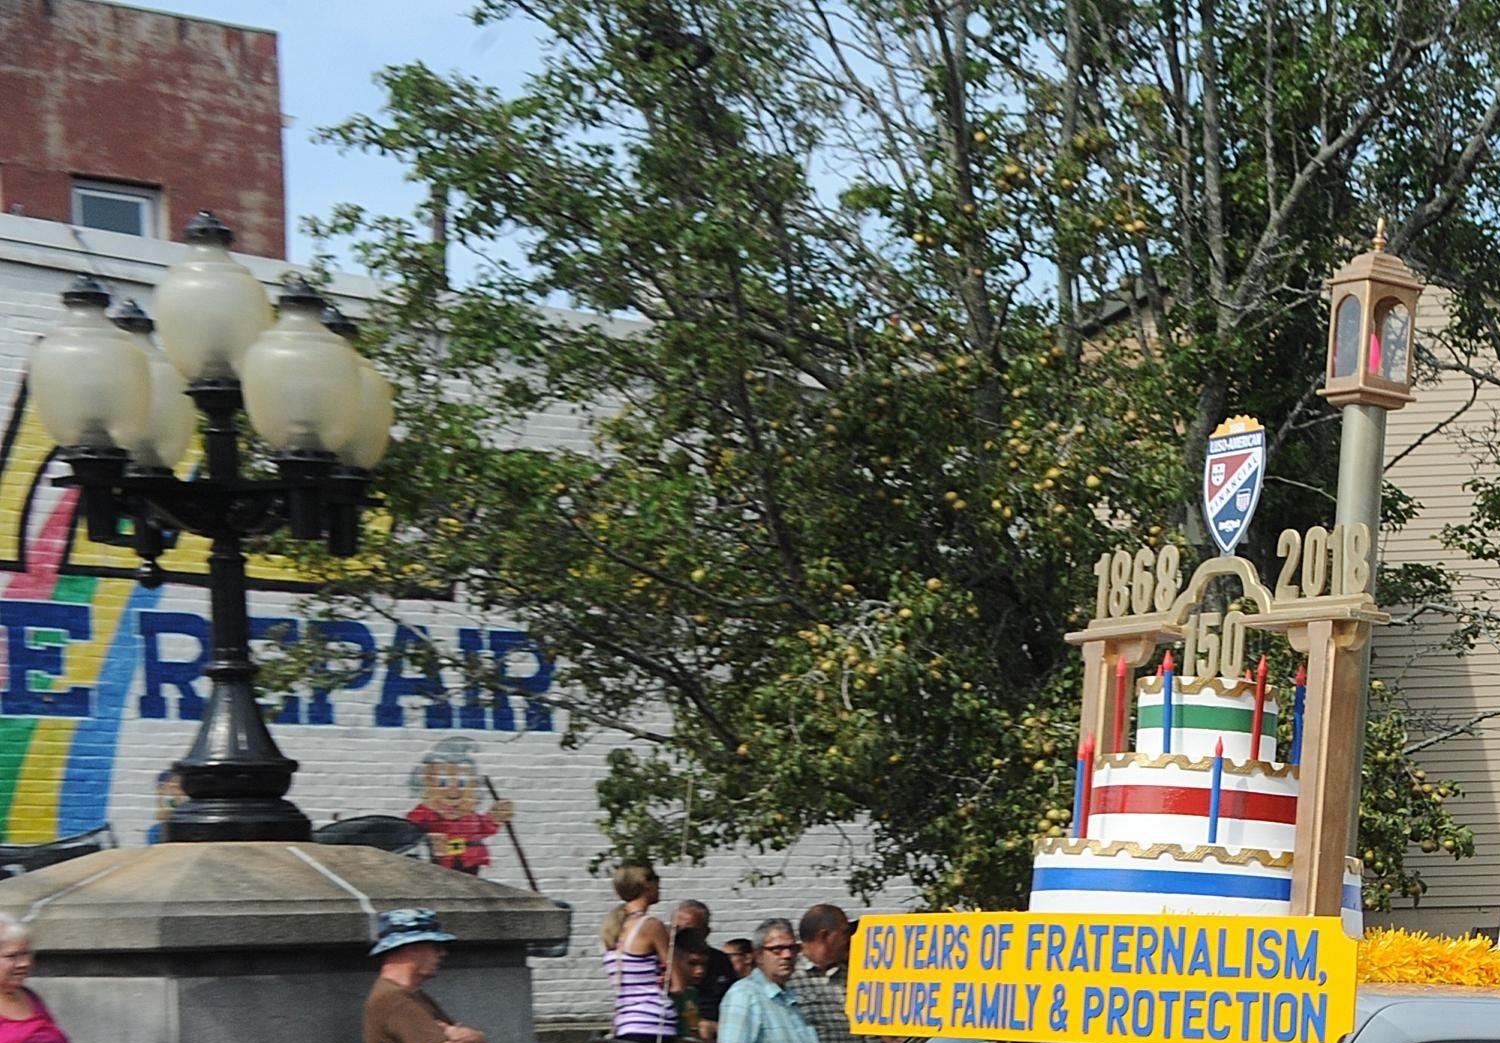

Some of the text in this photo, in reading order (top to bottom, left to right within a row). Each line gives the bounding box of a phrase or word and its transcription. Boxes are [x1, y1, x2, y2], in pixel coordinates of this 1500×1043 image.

[1094, 545, 1181, 620] 1868
[1275, 522, 1372, 601] 2018
[1182, 610, 1246, 679] 150
[863, 924, 1327, 986] 150 YEARS OF FRATERNALISM,
[855, 981, 1328, 1043] CULTURE, FAMILY & PROTECTION
